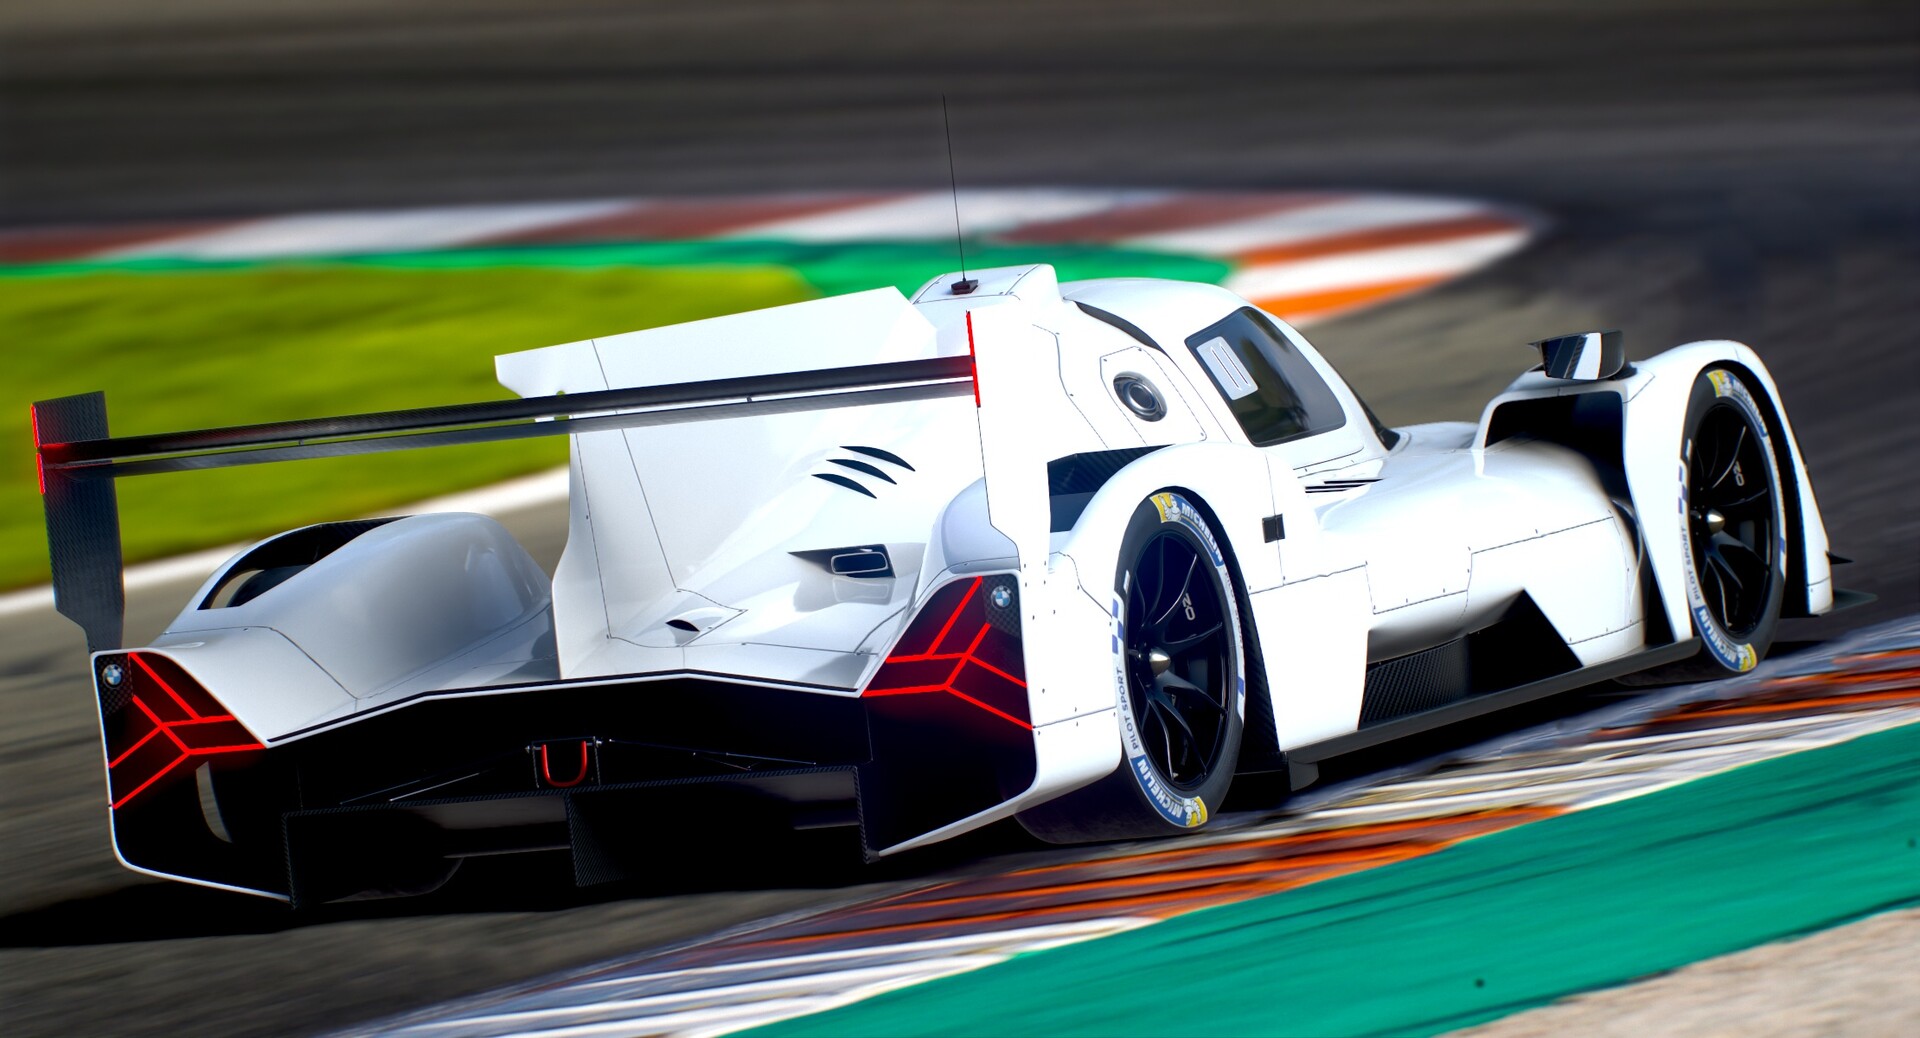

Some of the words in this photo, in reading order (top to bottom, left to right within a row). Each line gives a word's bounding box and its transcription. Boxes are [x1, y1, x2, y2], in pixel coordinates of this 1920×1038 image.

[1681, 525, 1691, 566] SPORT
[1688, 569, 1700, 600] PILOT
[1699, 608, 1737, 663] MICHELIN
[1116, 667, 1129, 712] SPORT
[1124, 715, 1139, 750] PILOT
[1137, 758, 1183, 818] MICHELIN
